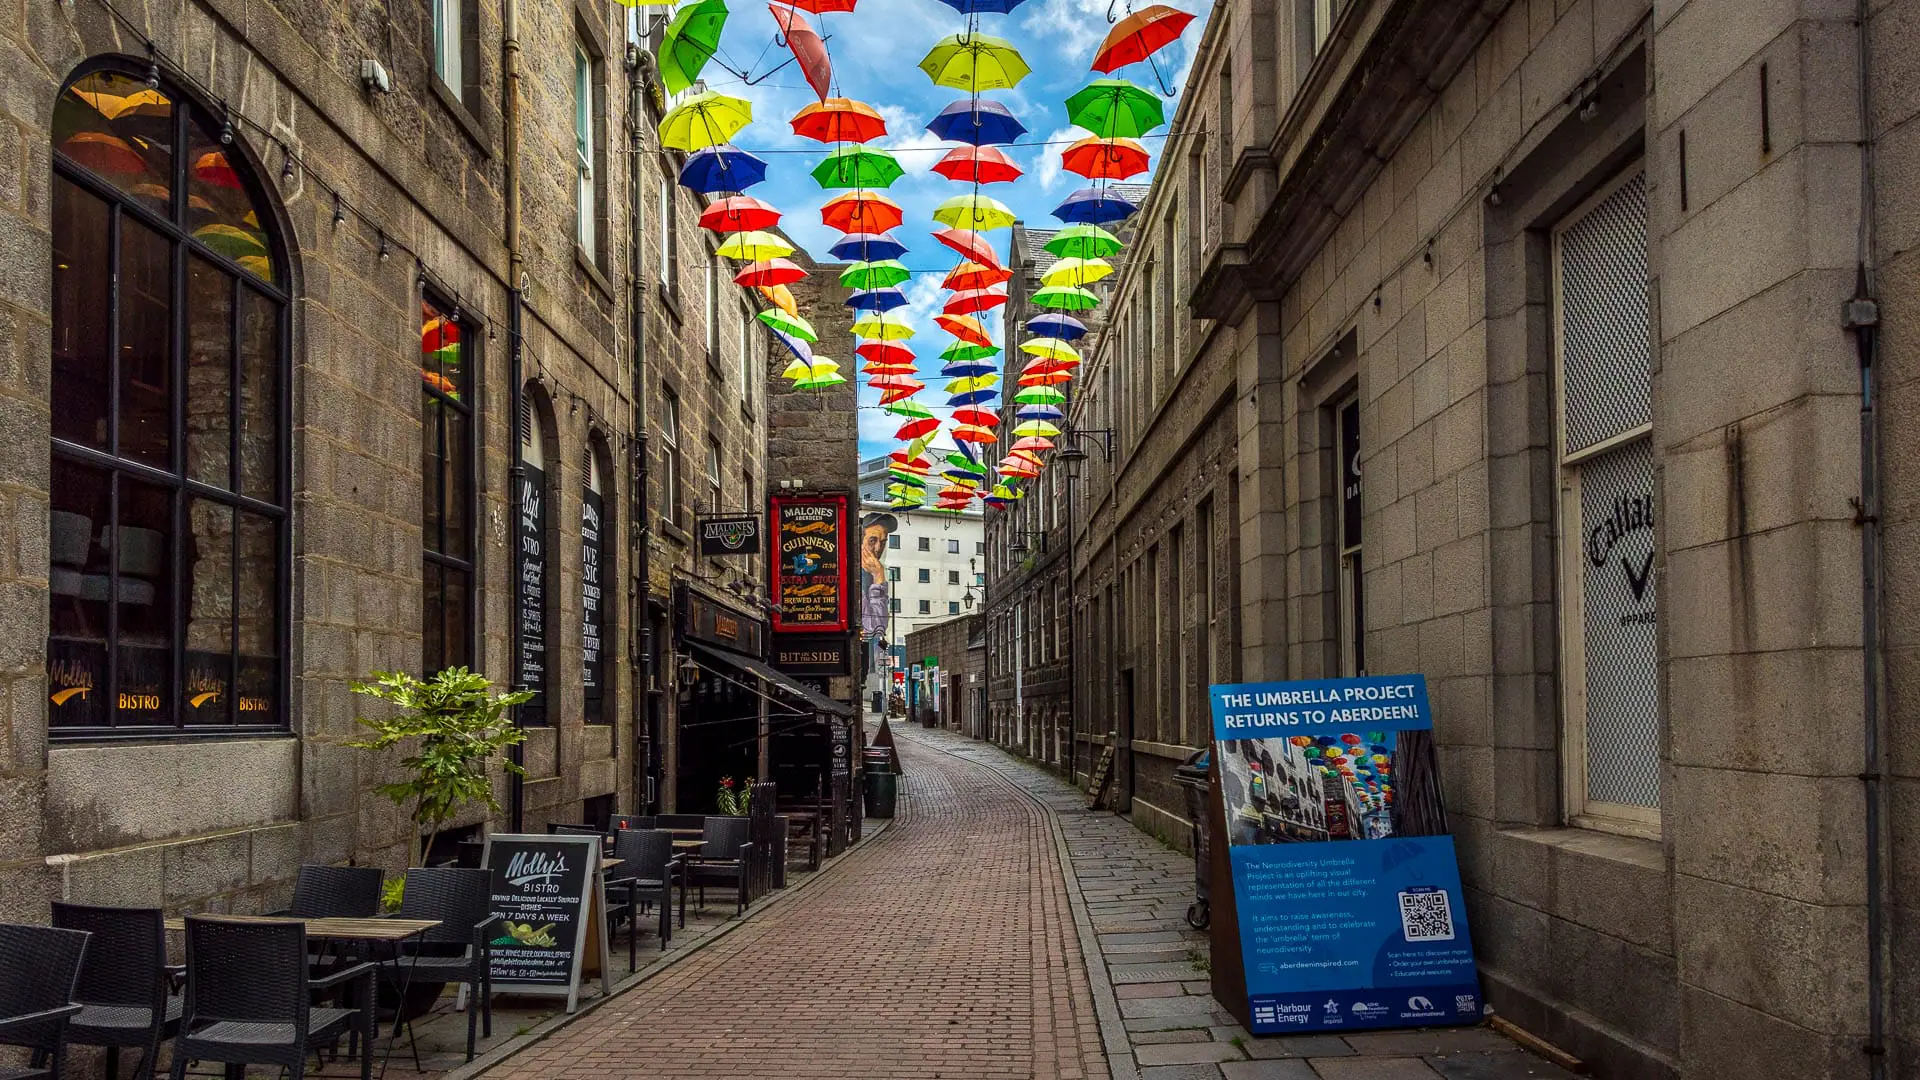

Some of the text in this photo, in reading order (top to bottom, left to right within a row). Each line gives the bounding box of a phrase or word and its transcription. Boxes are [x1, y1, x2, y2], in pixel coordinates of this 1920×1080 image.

[783, 507, 834, 518] MALONES
[704, 521, 754, 538] MALONES
[1590, 488, 1654, 567] Calla
[522, 535, 540, 556] STRO
[782, 535, 836, 553] GUINNESS
[584, 545, 598, 566] IVE
[583, 563, 598, 584] SIC
[798, 612, 822, 620] DUBLIN
[1621, 612, 1657, 626] APPARE
[780, 652, 800, 662] BIT
[812, 652, 840, 662] SIDE
[119, 693, 160, 710] BISTRO
[1221, 685, 1414, 708] THE UMBRELLA PROJECT
[239, 696, 270, 711] BISTRO
[1225, 705, 1420, 728] RETURNS TO ABERDEEN!
[505, 851, 570, 884] Molly's
[1262, 860, 1318, 869] Neurodiversity
[1320, 858, 1355, 866] Umbrella
[1247, 872, 1276, 881] Project
[1296, 870, 1328, 879] uplifting
[1330, 868, 1351, 876] visual
[524, 883, 560, 893] BISTRO
[1248, 882, 1304, 892] representation
[1342, 878, 1376, 886] different
[1352, 889, 1368, 898] city.
[515, 912, 537, 920] DAYS
[1254, 923, 1310, 933] understanding
[1339, 920, 1376, 928] celebrate
[1256, 936, 1268, 944] the
[1332, 932, 1340, 940] of
[1280, 960, 1359, 969] aberdeeninspired.com
[1276, 1002, 1312, 1013] Harbour
[1278, 1013, 1309, 1024] Energy
